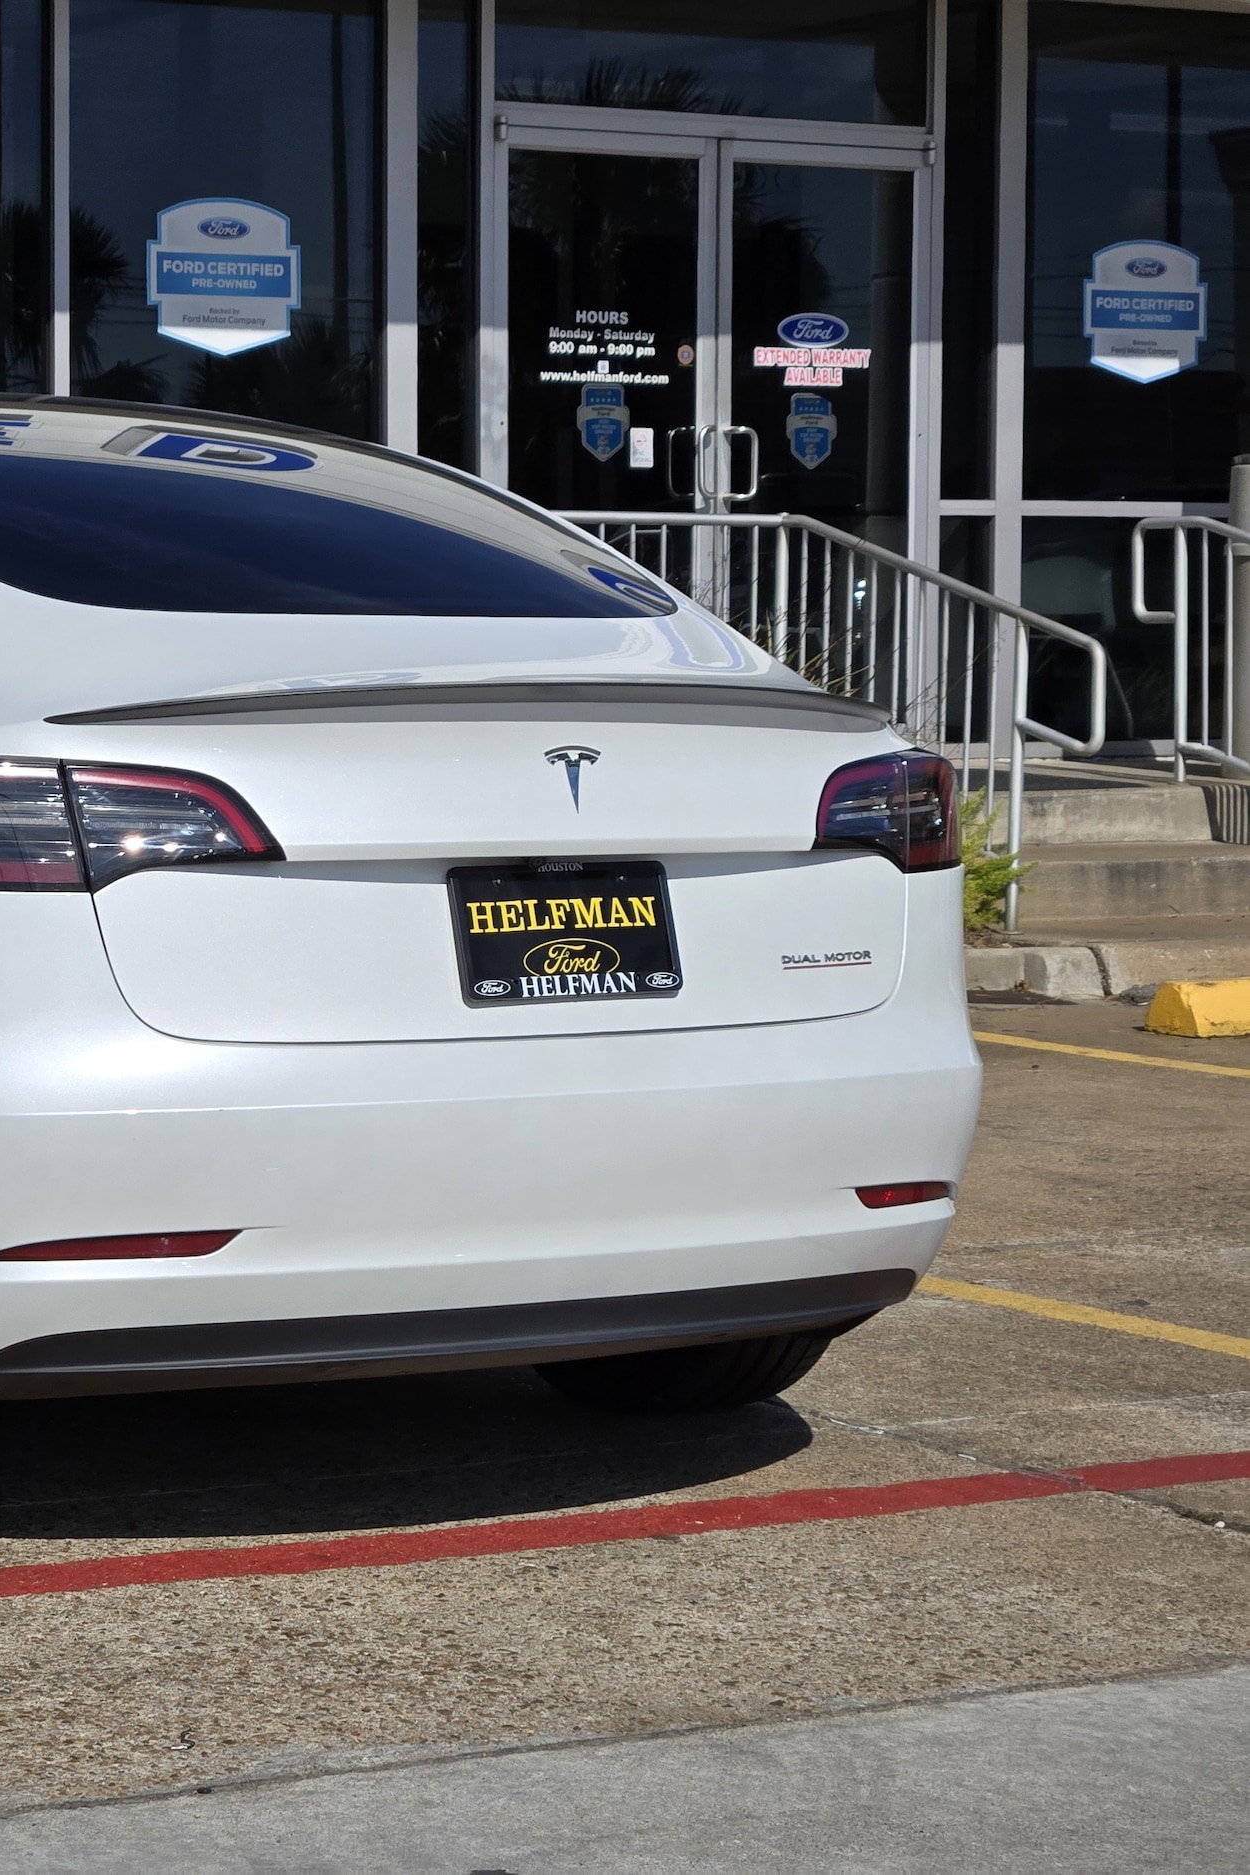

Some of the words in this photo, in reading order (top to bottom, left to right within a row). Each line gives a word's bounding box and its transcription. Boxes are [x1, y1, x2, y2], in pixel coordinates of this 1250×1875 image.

[208, 220, 240, 236] Ford
[162, 259, 205, 274] FORD
[207, 261, 285, 277] CERTIFIED
[1132, 260, 1159, 275] Ford
[191, 278, 257, 289] PRE-OWNED
[209, 307, 230, 315] Backed
[232, 308, 240, 316] by
[1096, 297, 1130, 309] FORD
[1132, 298, 1195, 311] CERTIFIED
[182, 314, 201, 323] Ford
[202, 315, 227, 324] Motor
[228, 316, 266, 327] Company
[575, 310, 629, 325] HOURS
[1119, 313, 1172, 323] PRE-OWNED
[549, 327, 595, 342] Monday
[604, 328, 656, 344] Saturday
[793, 319, 834, 341] Ford
[549, 341, 575, 354] 9:00
[578, 344, 597, 355] am
[607, 343, 634, 356] 9:00
[636, 346, 656, 358] pm
[755, 348, 810, 365] EXTENDED
[812, 349, 870, 367] WARRANTY
[540, 370, 670, 385] www.helfmanford.com
[786, 367, 842, 385] AVAILABLE
[466, 896, 657, 934] HELFMAN
[543, 943, 601, 975] Ford
[781, 954, 821, 964] DUAL
[824, 950, 872, 962] MOTOR
[480, 982, 505, 994] Ford
[519, 971, 637, 998] HELFMAN
[651, 974, 675, 986] Ford
